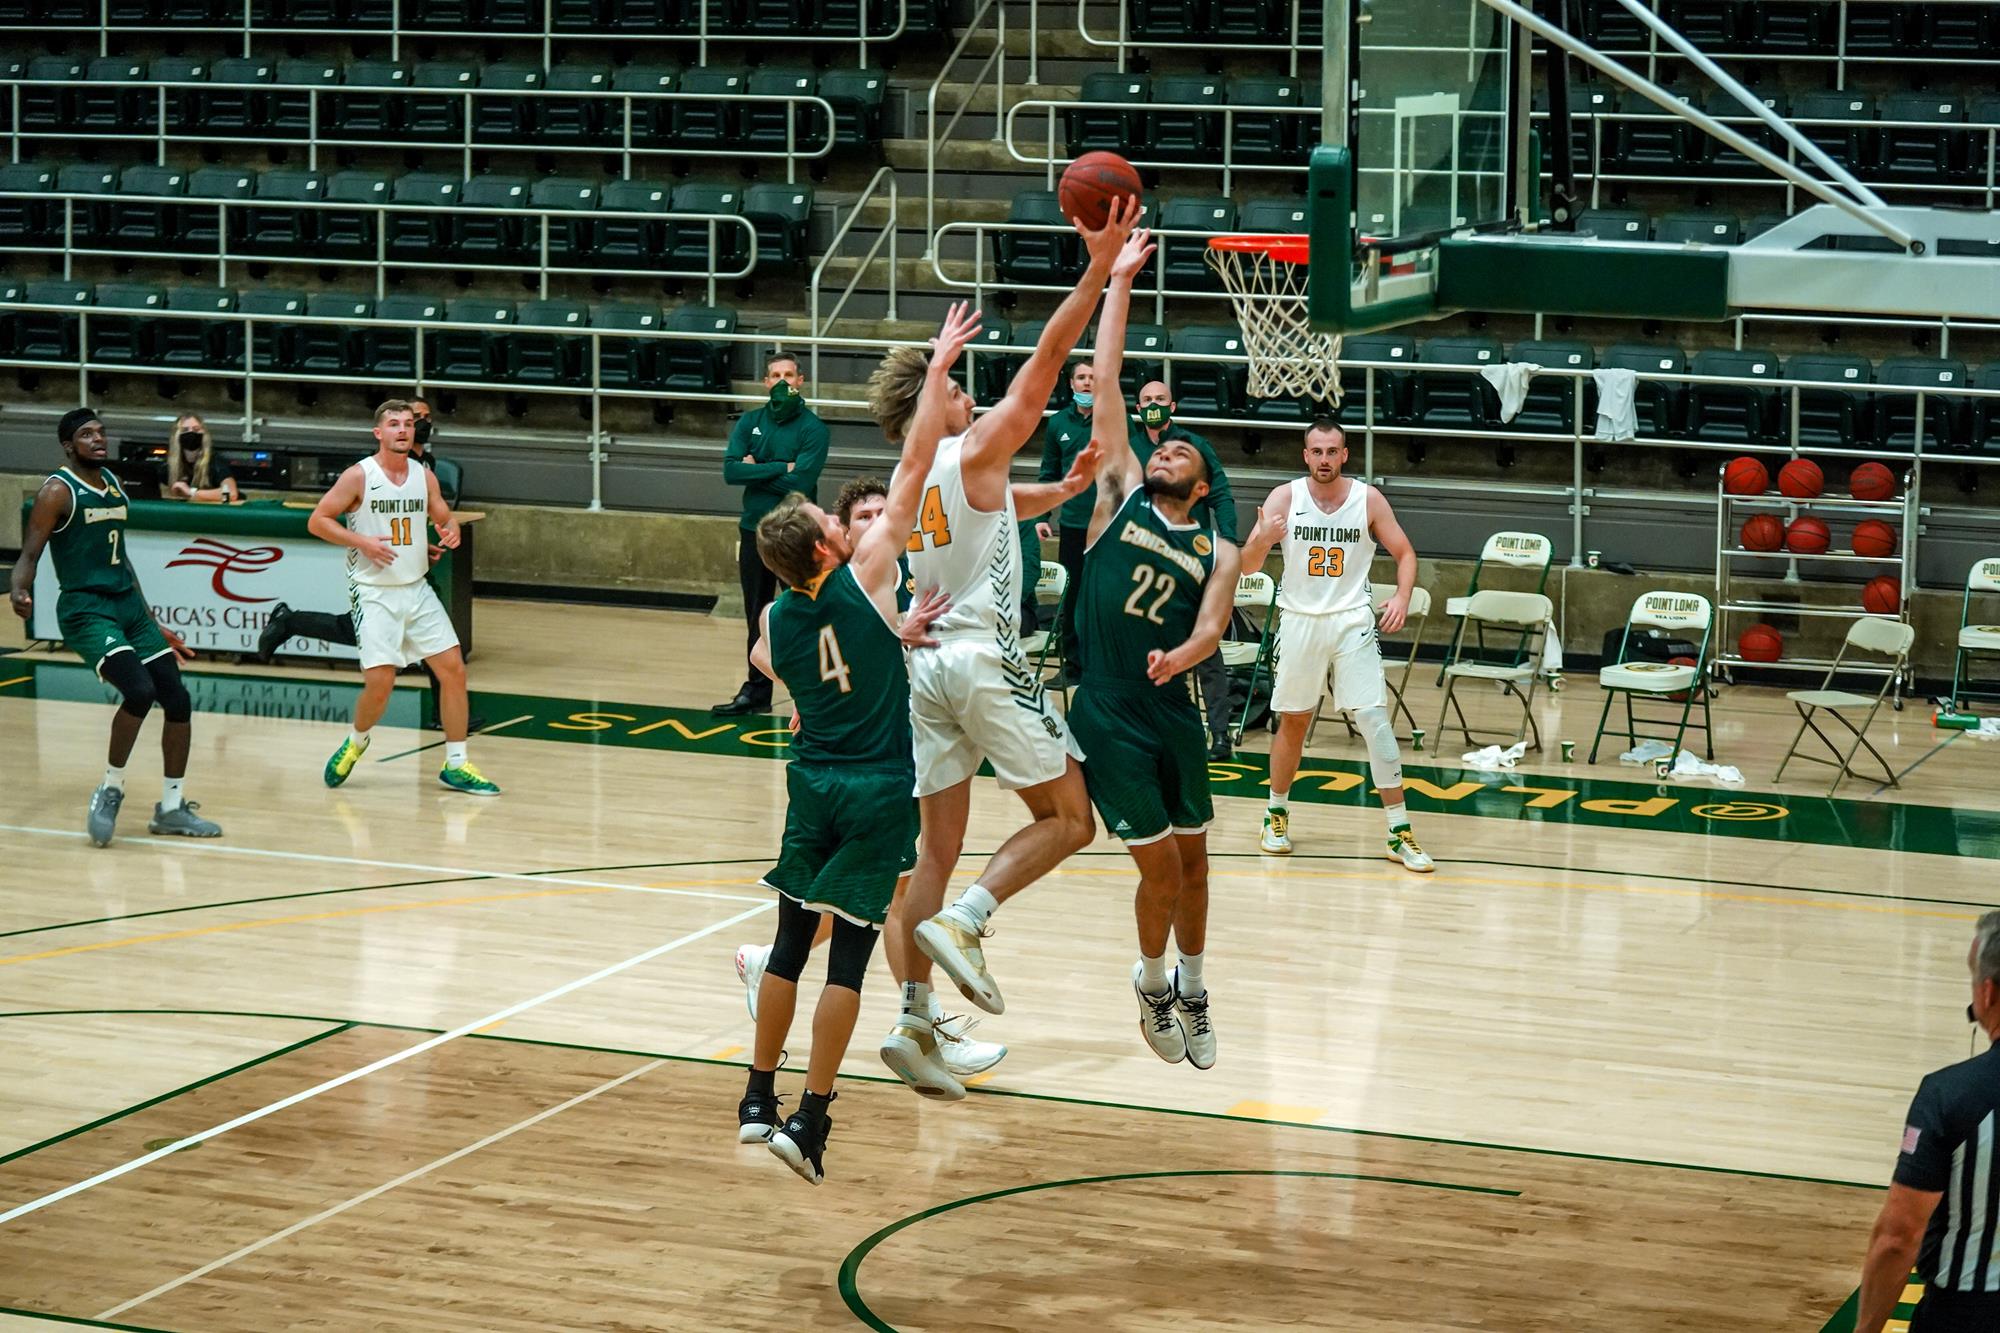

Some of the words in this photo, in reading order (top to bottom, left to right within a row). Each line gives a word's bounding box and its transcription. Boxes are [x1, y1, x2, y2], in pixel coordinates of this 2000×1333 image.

[371, 499, 400, 513] POINT
[390, 517, 412, 546] 11
[1294, 525, 1328, 542] POINT
[1330, 527, 1360, 543] LOMA
[108, 529, 121, 565] 2
[1496, 536, 1519, 549] POINT
[1520, 538, 1541, 550] LOMA
[1308, 546, 1344, 577] 23
[1982, 563, 2000, 575] POI
[1239, 577, 1264, 590] LOMA
[1124, 564, 1176, 625] 22
[1645, 597, 1673, 611] POINT
[1674, 599, 1699, 612] LOMA
[818, 624, 852, 693] 4
